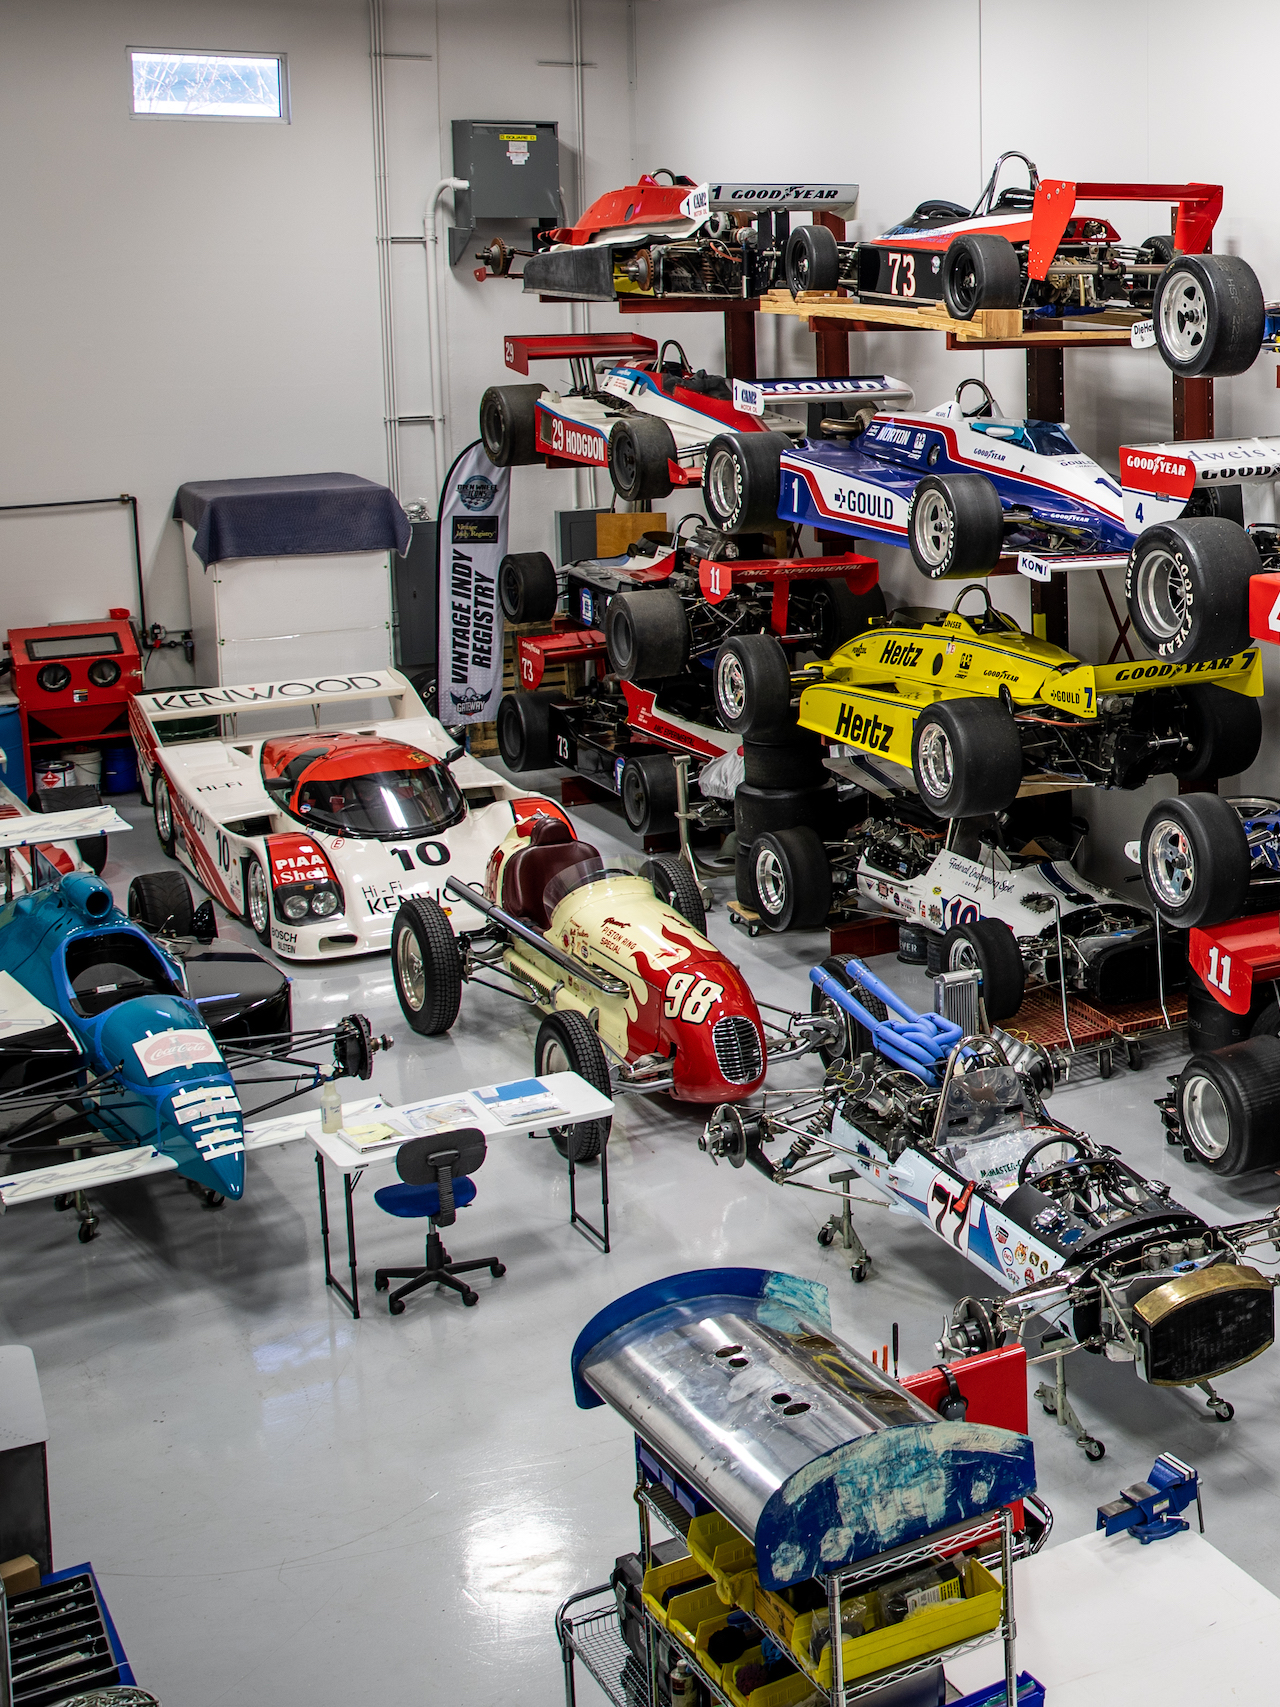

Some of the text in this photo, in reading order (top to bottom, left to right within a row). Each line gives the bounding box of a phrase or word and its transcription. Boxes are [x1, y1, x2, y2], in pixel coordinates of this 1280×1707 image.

[711, 185, 723, 200] 1
[887, 252, 916, 297] 73
[504, 342, 515, 363] 29
[734, 385, 738, 401] 1
[946, 404, 953, 418] 1
[551, 417, 564, 452] 29
[565, 428, 605, 462] HODGDON
[876, 426, 912, 446] NORTON
[1060, 459, 1095, 467] GOULD
[791, 478, 799, 513] 1
[847, 489, 894, 521] GOULD
[1135, 502, 1144, 523] 4
[737, 563, 865, 577] AMC EXPERIMENTAL
[1021, 557, 1047, 577] KONI
[709, 566, 721, 596] 11
[450, 548, 473, 685] VINTAGE INDY
[471, 570, 495, 670] REGISTRY
[879, 639, 924, 668] Hertz
[1239, 651, 1256, 670] 7
[521, 657, 534, 683] 73
[151, 676, 382, 711] KENWOOD
[1056, 690, 1081, 705] GOULD
[1083, 686, 1093, 709] 7
[456, 701, 486, 713] GATEWAY
[663, 727, 696, 747] EXPERIMENTAL
[834, 702, 895, 753] Hertz
[556, 734, 569, 760] 73
[215, 829, 230, 873] 10
[275, 854, 325, 871] PIAA
[390, 840, 452, 872] 10
[948, 856, 972, 878] Federal
[361, 880, 403, 899] Hi Fi
[950, 894, 979, 926] 10
[271, 926, 298, 944] BOSCH
[599, 937, 621, 955] SPECIAL
[601, 926, 638, 950] PISTON RING
[277, 941, 297, 954] BILSTEIN
[1207, 946, 1232, 997] 11
[663, 971, 725, 1024] 98
[931, 1181, 970, 1251] 77
